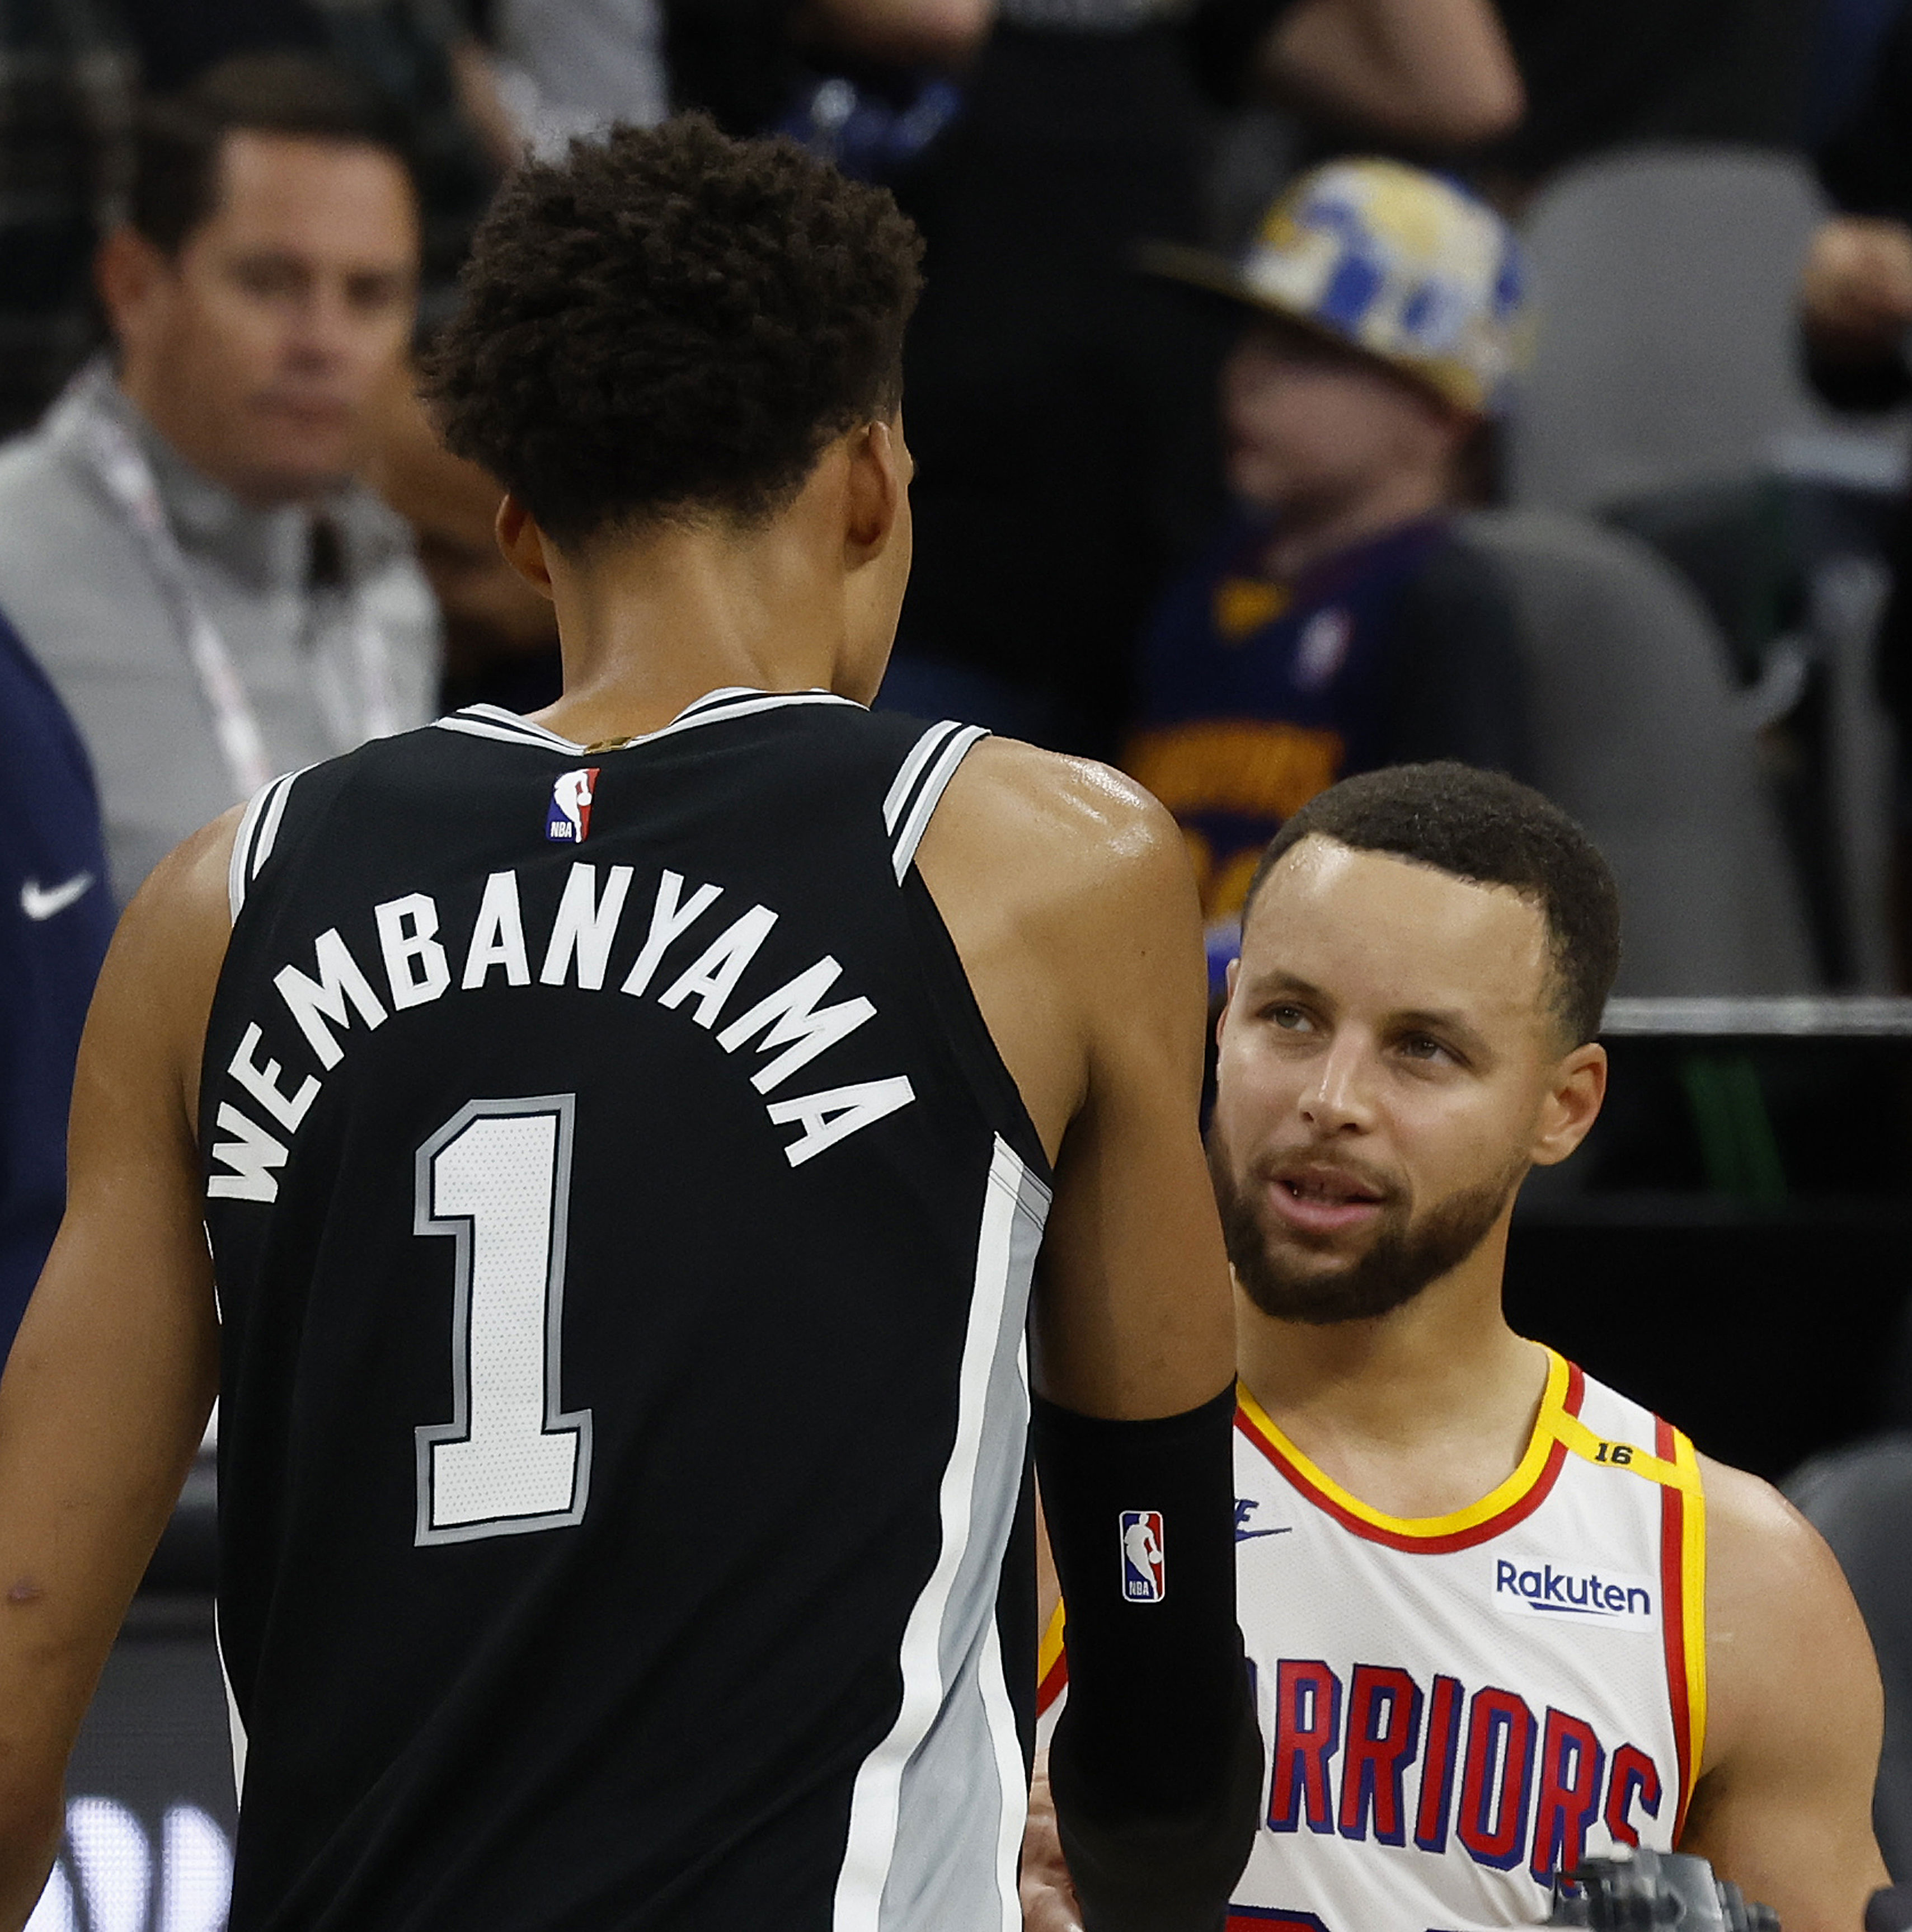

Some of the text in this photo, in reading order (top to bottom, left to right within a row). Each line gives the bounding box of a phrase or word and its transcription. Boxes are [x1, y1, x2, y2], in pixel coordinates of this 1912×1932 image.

[550, 821, 572, 838] NBA
[205, 861, 917, 1204] WEMBANYAMA
[412, 1092, 593, 1548] 1
[1595, 1442, 1633, 1465] 16
[1129, 1581, 1149, 1596] NBA
[1496, 1559, 1651, 1615] Rakuten
[1244, 1657, 1662, 1898] RRIORS
